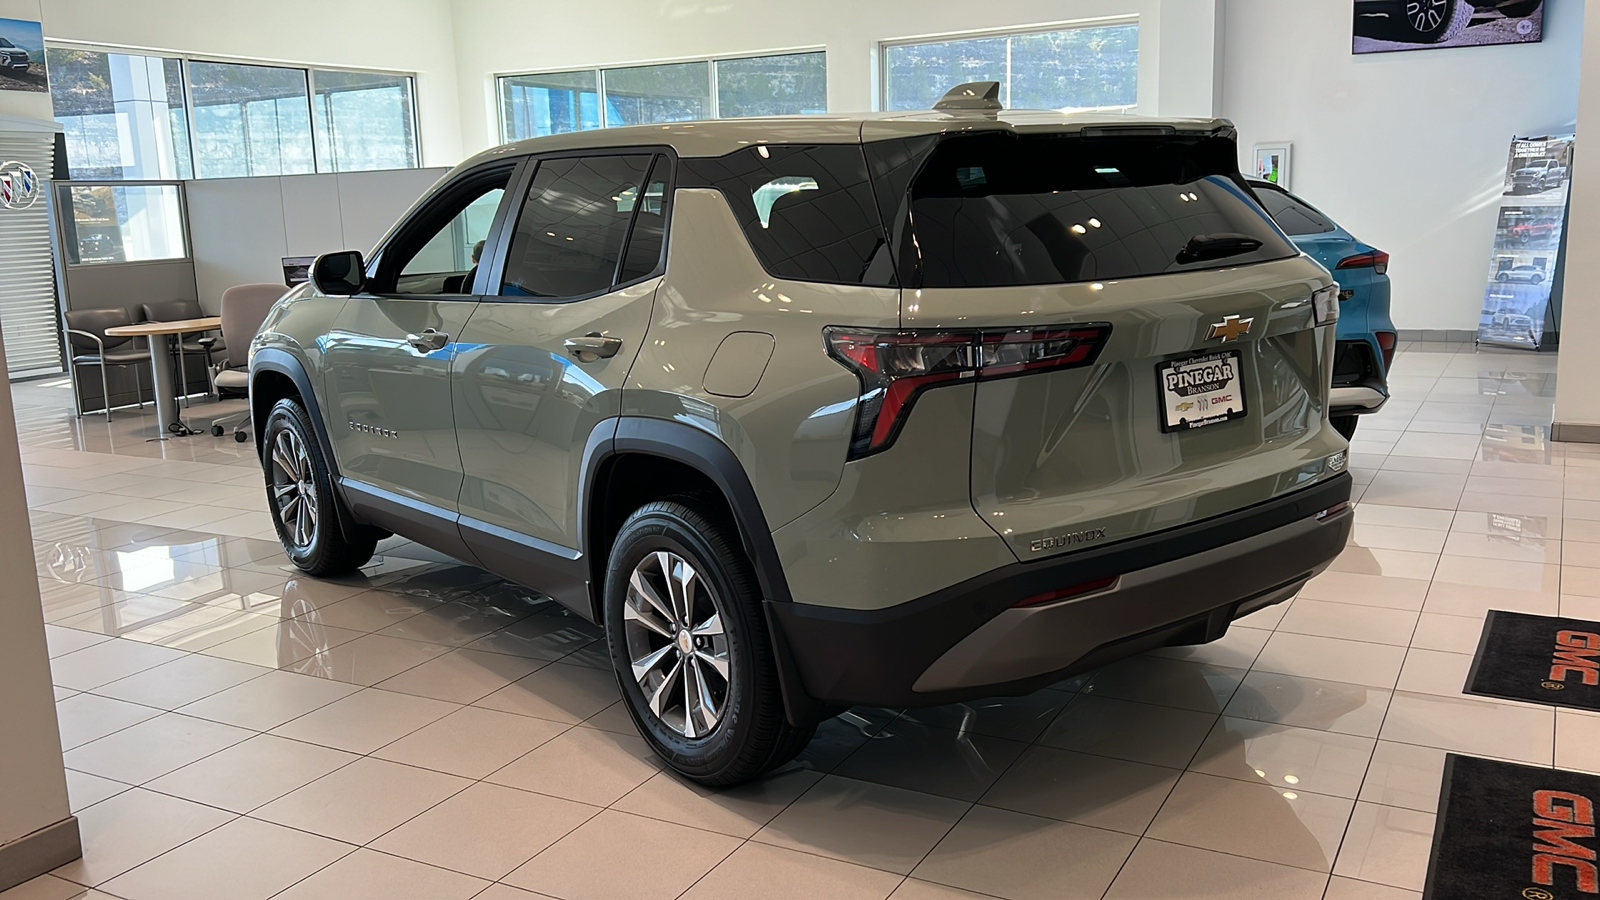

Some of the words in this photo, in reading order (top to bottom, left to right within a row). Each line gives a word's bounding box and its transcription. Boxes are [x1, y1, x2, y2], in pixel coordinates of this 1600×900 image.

[1209, 353, 1221, 361] Buick
[1221, 351, 1232, 359] GMC
[1167, 365, 1233, 390] PINEGAR
[1187, 383, 1220, 395] BRANSON
[1211, 394, 1233, 405] GMC
[348, 420, 398, 439] EQUINOX
[1031, 526, 1106, 552] EQUINOX
[1549, 630, 1600, 686] GMC
[1532, 789, 1599, 893] GMC
